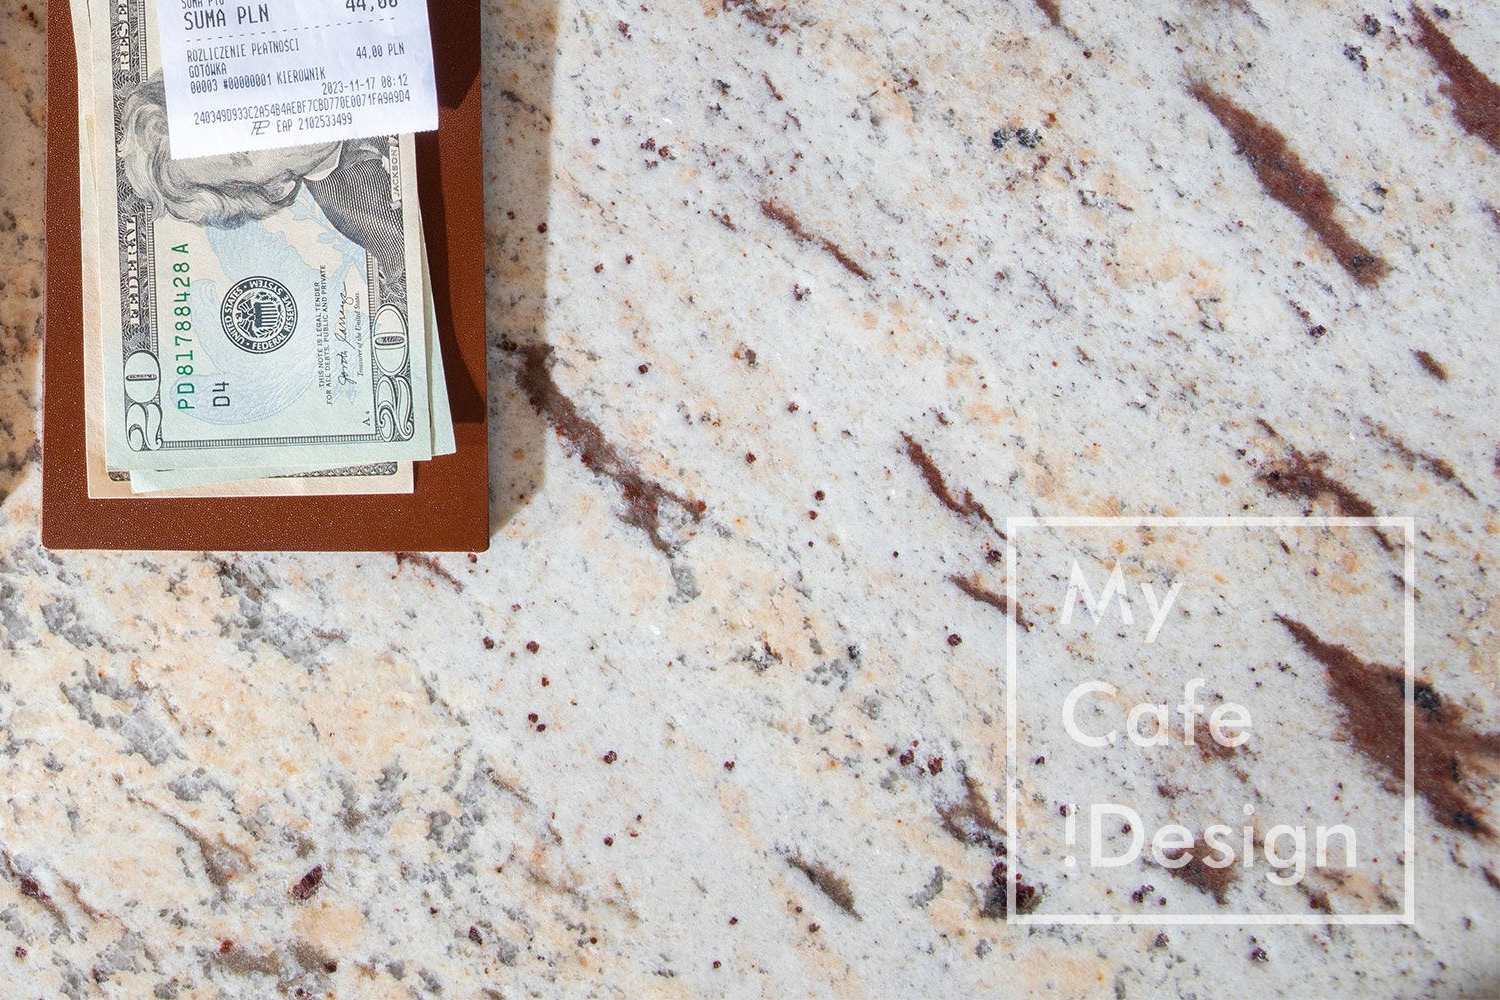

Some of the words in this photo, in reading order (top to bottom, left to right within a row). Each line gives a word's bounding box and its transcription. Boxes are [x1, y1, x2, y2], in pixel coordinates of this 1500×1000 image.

[183, 9, 226, 30] SUMA
[237, 3, 270, 25] PLN
[186, 43, 246, 63] ROZLICZENIE
[251, 37, 300, 56] PŁATNOŚCI
[188, 62, 227, 78] GOTÓWKA
[356, 44, 383, 59] 44,00
[388, 42, 405, 56] PLN
[190, 78, 218, 94] 00003
[277, 66, 326, 85] KIEROWNIK
[322, 77, 375, 95] 2023-11-17
[381, 73, 408, 89] 08:12
[276, 118, 293, 133] EAP
[299, 112, 353, 130] 2102533499
[390, 149, 400, 197] JACKSON
[125, 214, 141, 325] FEDERAL
[224, 286, 243, 313] STATES
[249, 279, 284, 296] SYSTEM
[281, 294, 295, 333] RESERVE
[225, 315, 245, 345] UNITED
[251, 332, 287, 350] FEDERAL
[322, 314, 330, 343] PUBLIC
[317, 338, 323, 347] IS
[372, 303, 414, 442] 20
[124, 350, 163, 452] 20
[212, 381, 230, 407] D4
